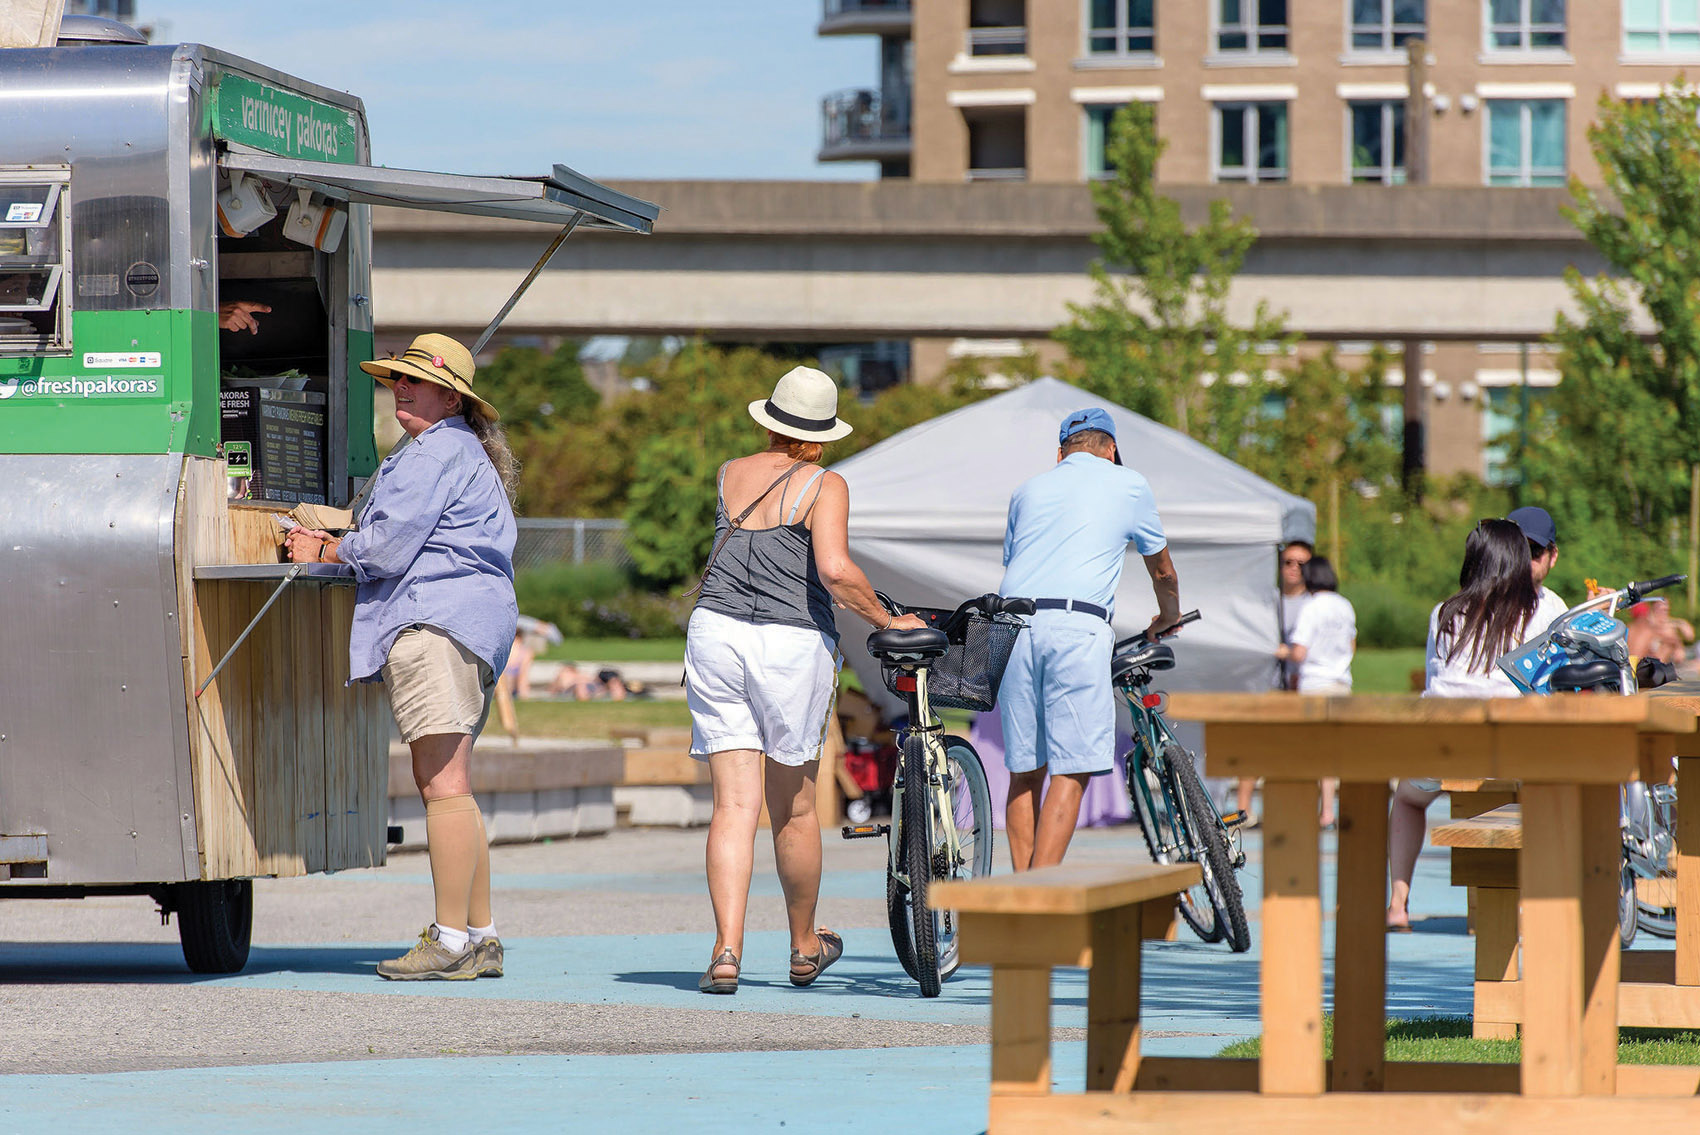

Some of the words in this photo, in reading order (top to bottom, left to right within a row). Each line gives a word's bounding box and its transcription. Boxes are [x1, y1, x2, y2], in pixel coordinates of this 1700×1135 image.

[241, 87, 292, 152] varinicey
[296, 105, 338, 157] pakoras
[21, 375, 157, 398] @freshpakoras
[219, 391, 250, 400] AKORAS
[227, 400, 250, 408] FRESH
